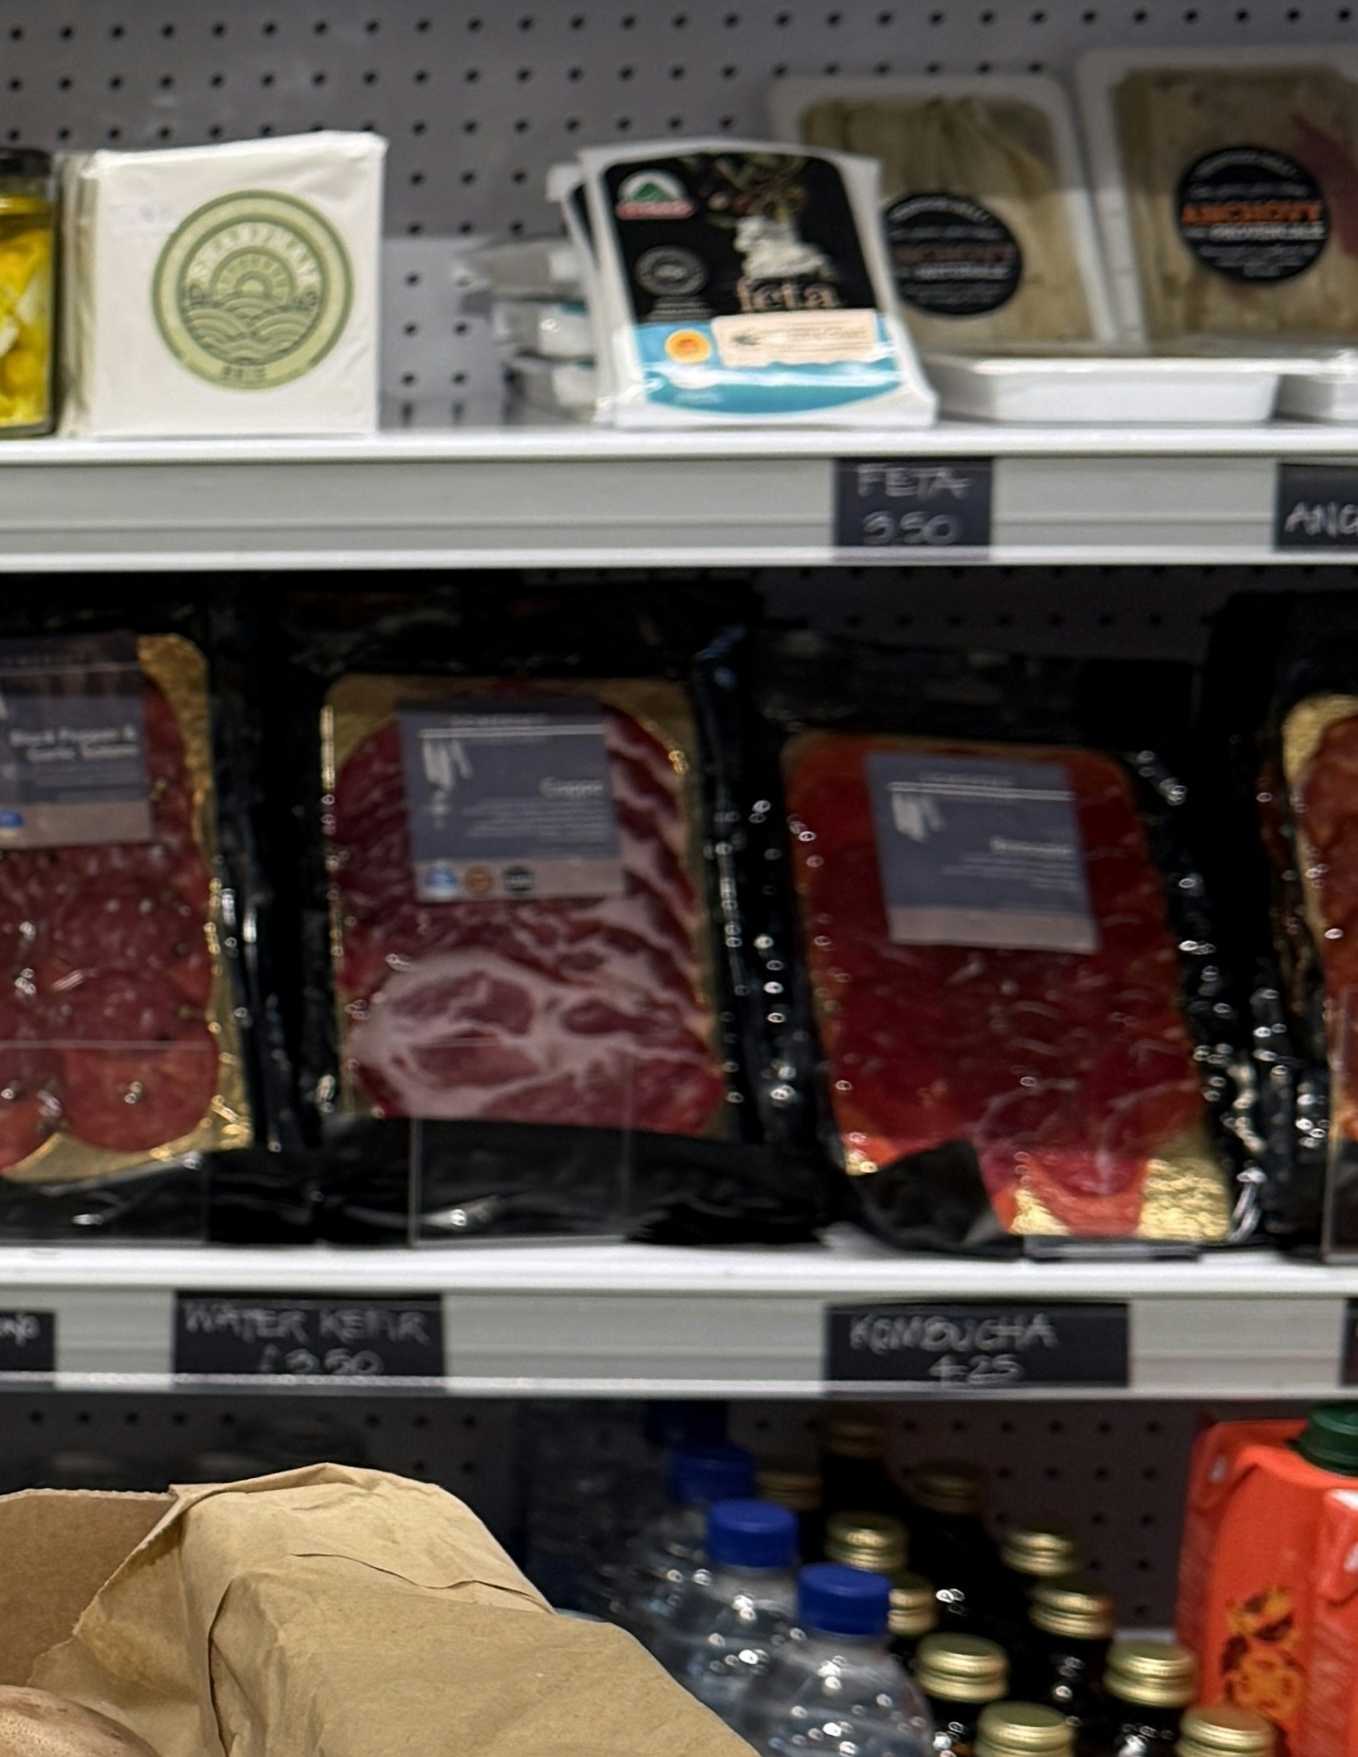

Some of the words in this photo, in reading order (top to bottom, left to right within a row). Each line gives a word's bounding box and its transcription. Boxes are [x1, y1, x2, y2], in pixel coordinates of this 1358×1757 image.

[857, 463, 973, 501] FETA
[182, 1303, 306, 1345] WATER
[847, 1312, 1061, 1354] KOMBUCHA
